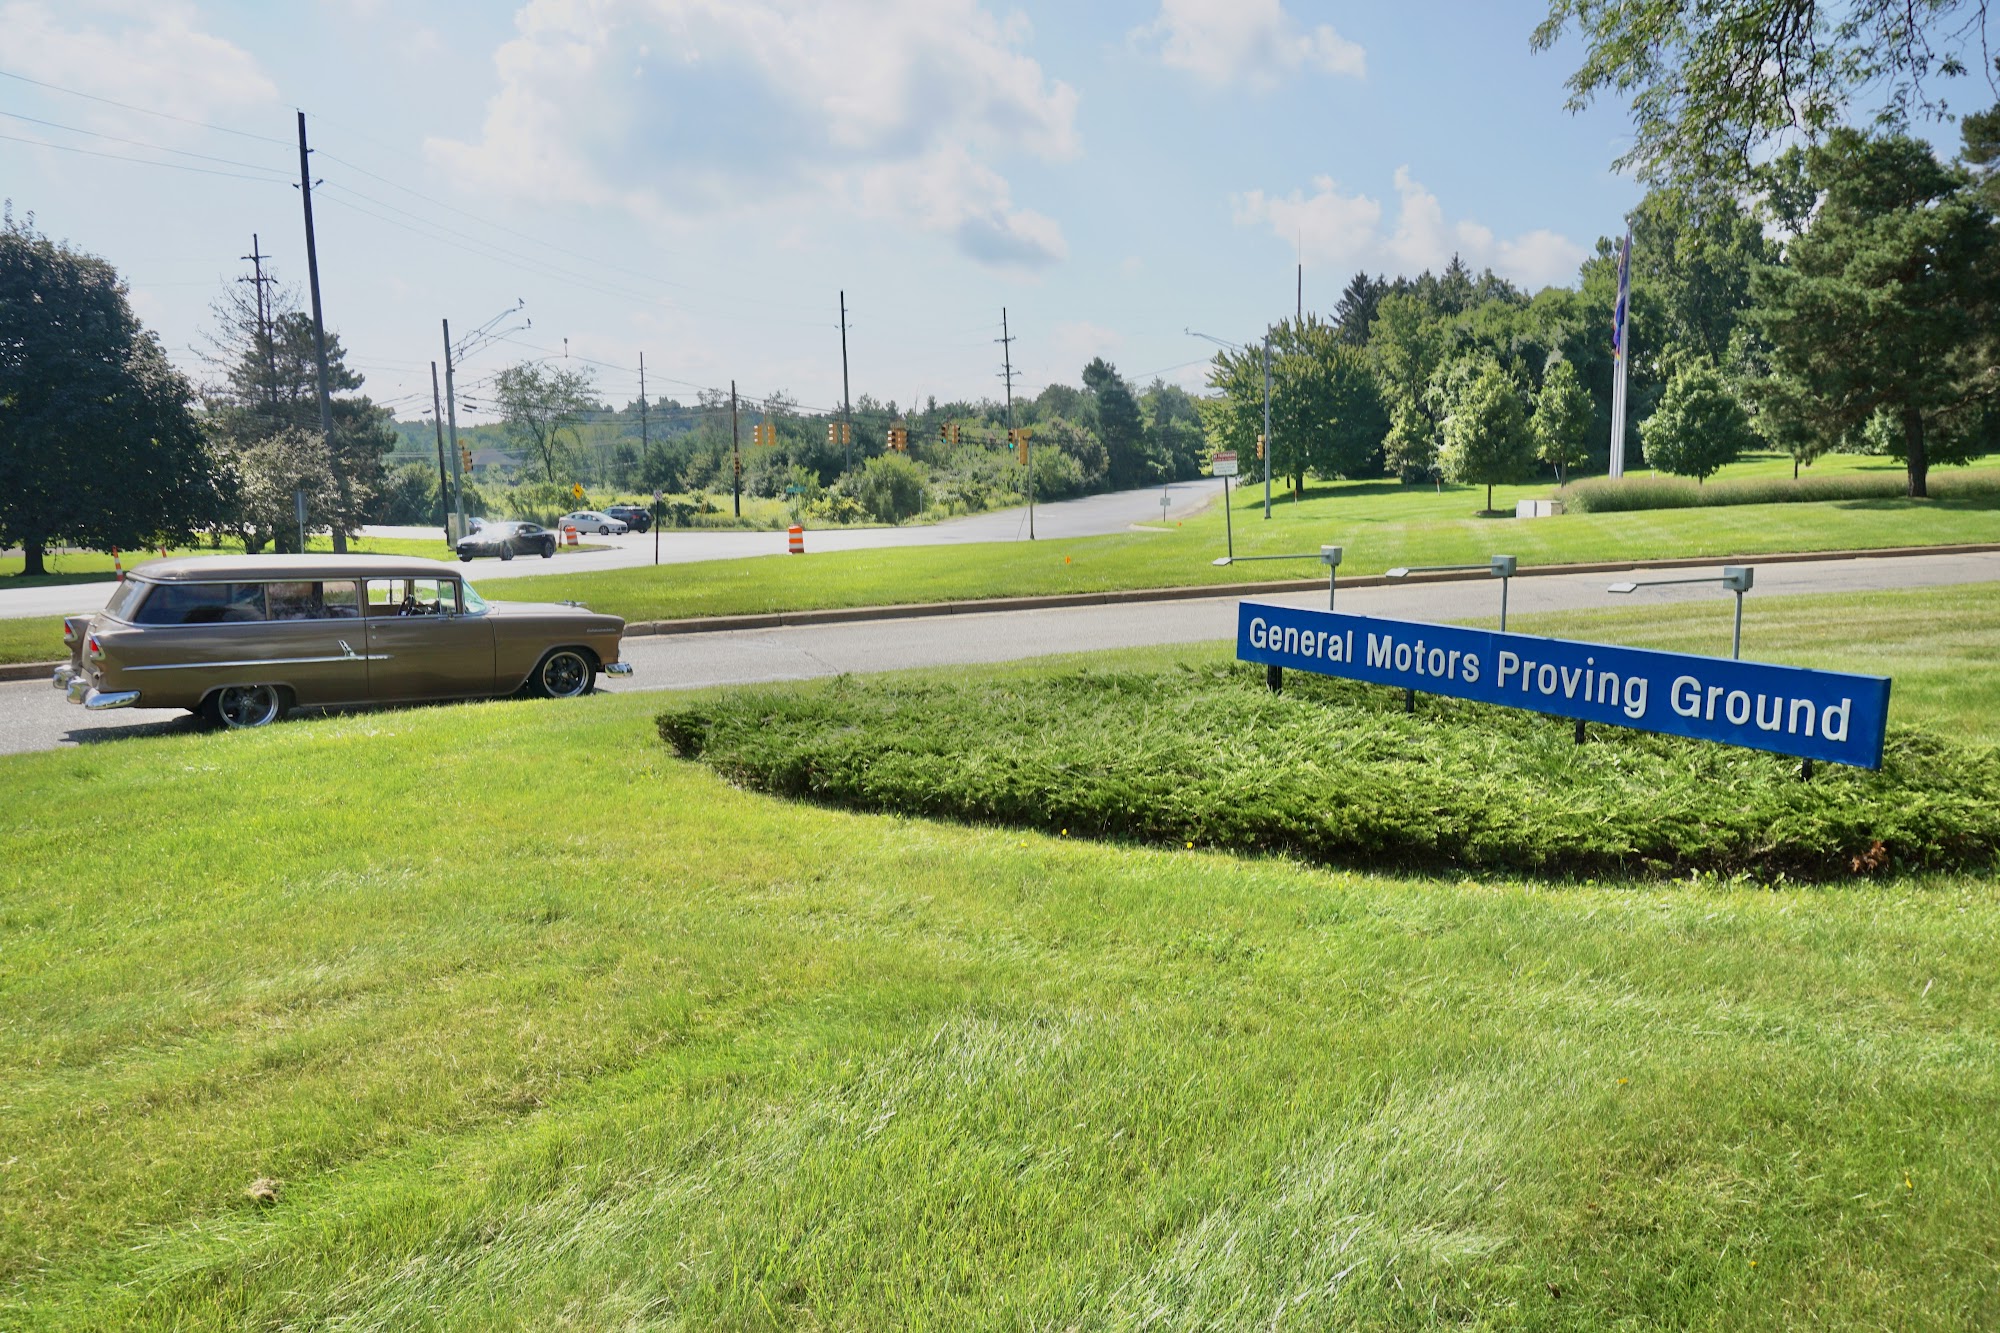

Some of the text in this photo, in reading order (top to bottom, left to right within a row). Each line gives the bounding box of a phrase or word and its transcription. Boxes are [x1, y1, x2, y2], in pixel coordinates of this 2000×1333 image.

[1250, 617, 1851, 742] General Motors Proving Ground
